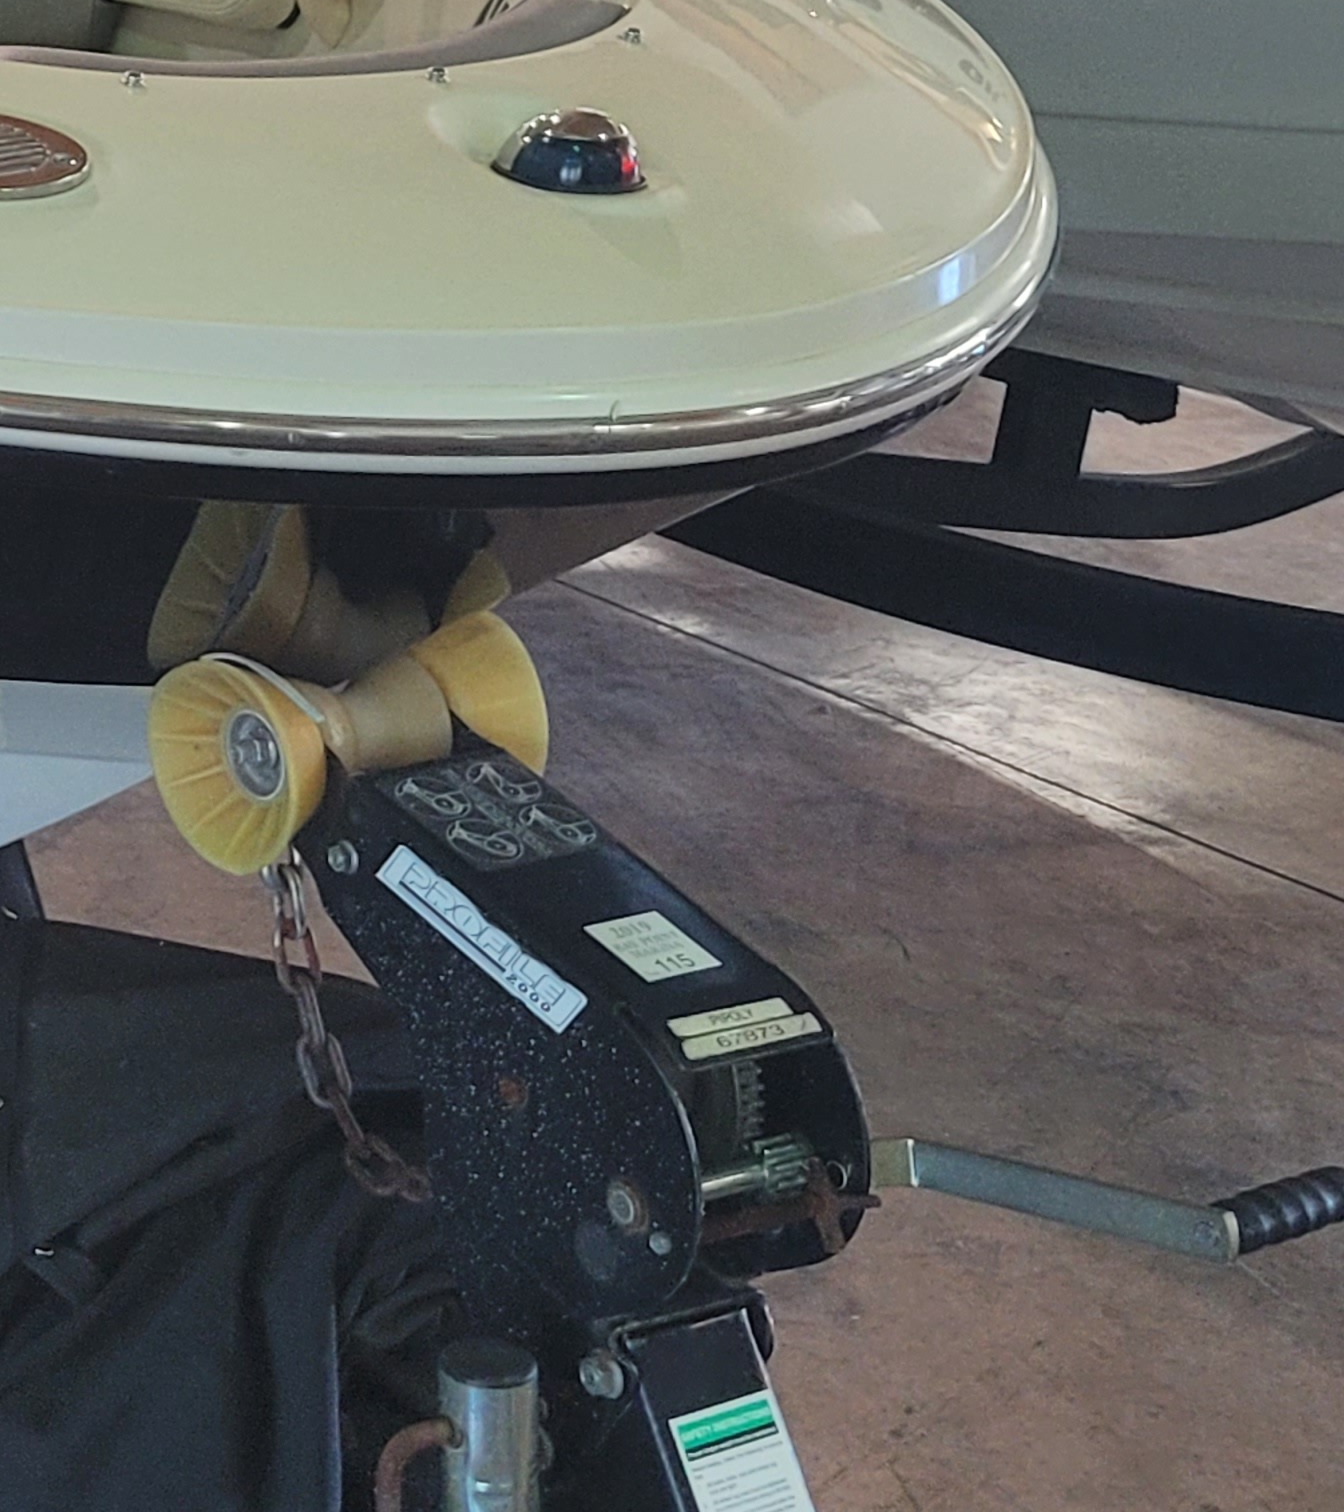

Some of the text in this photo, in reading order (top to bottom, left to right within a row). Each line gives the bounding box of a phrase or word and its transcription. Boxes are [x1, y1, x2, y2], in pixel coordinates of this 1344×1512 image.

[400, 861, 567, 1006] PROFILE
[654, 953, 696, 974] 115
[505, 973, 551, 1012] 2000
